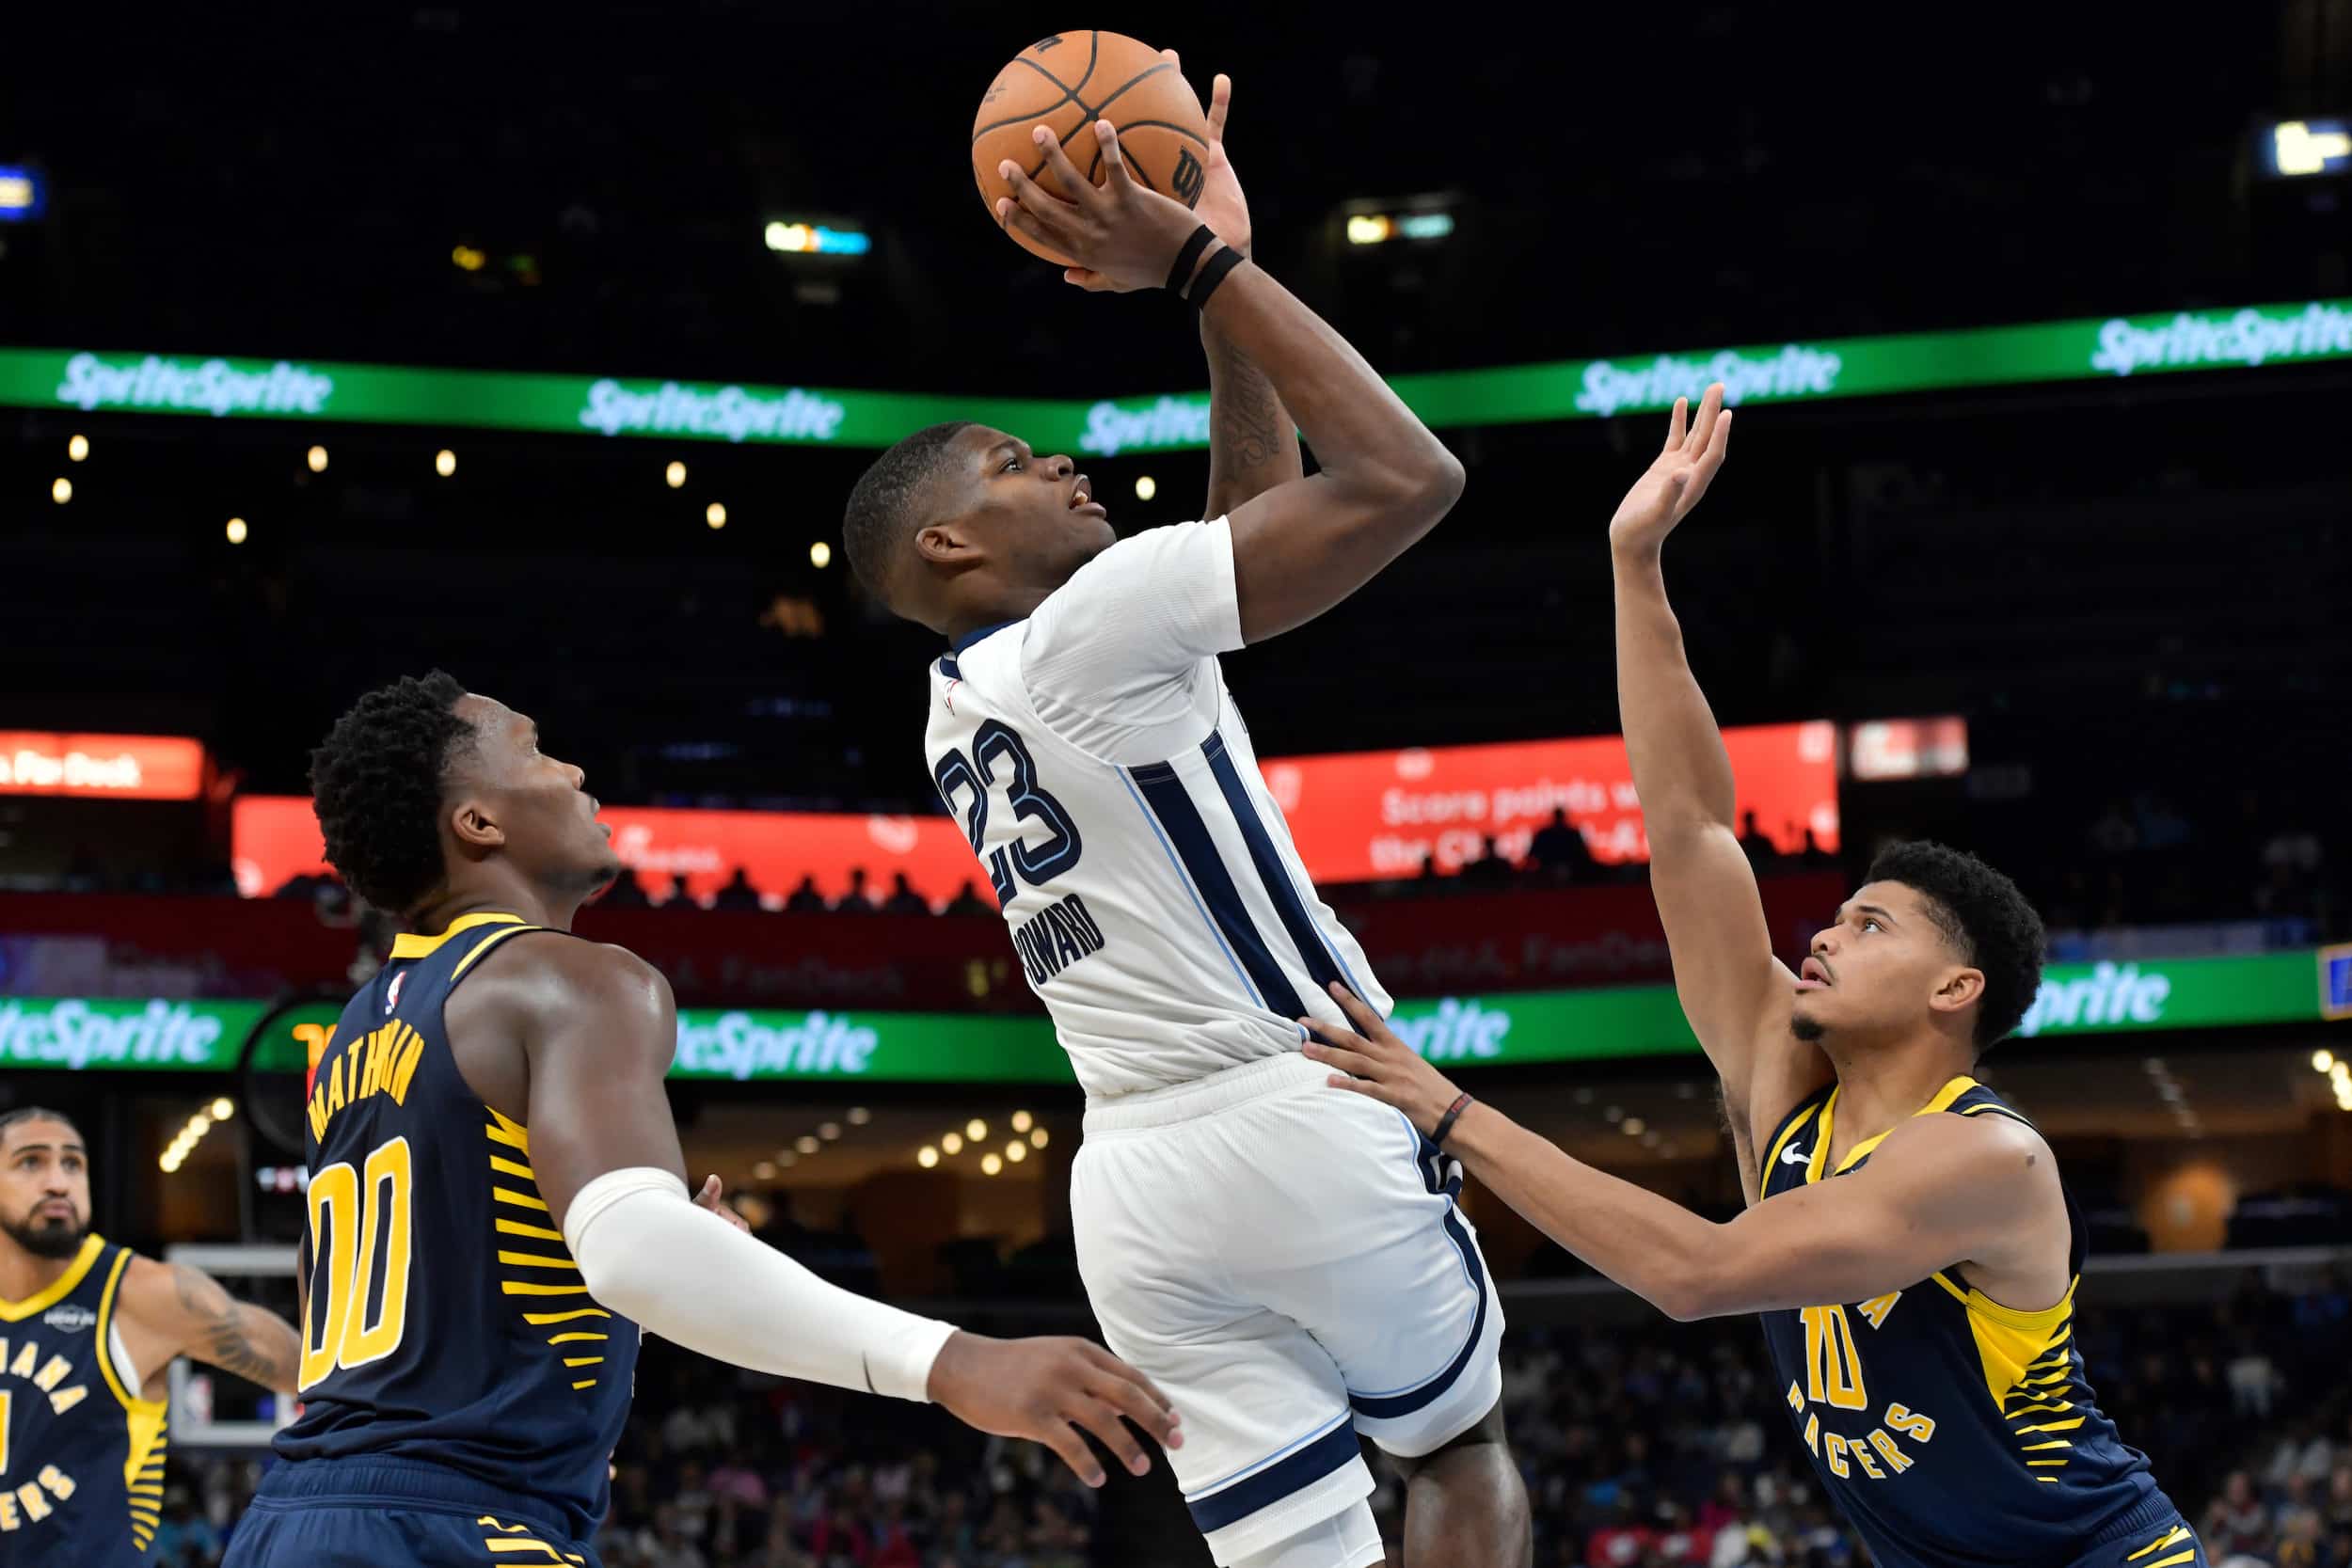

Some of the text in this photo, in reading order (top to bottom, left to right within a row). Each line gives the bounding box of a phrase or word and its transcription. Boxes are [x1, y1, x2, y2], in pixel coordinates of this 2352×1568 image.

[935, 719, 1082, 911] 23
[1015, 894, 1104, 990] OWARD
[298, 1135, 411, 1392] 00
[1800, 1304, 1868, 1411] 10
[1787, 1379, 1936, 1480] PACERS
